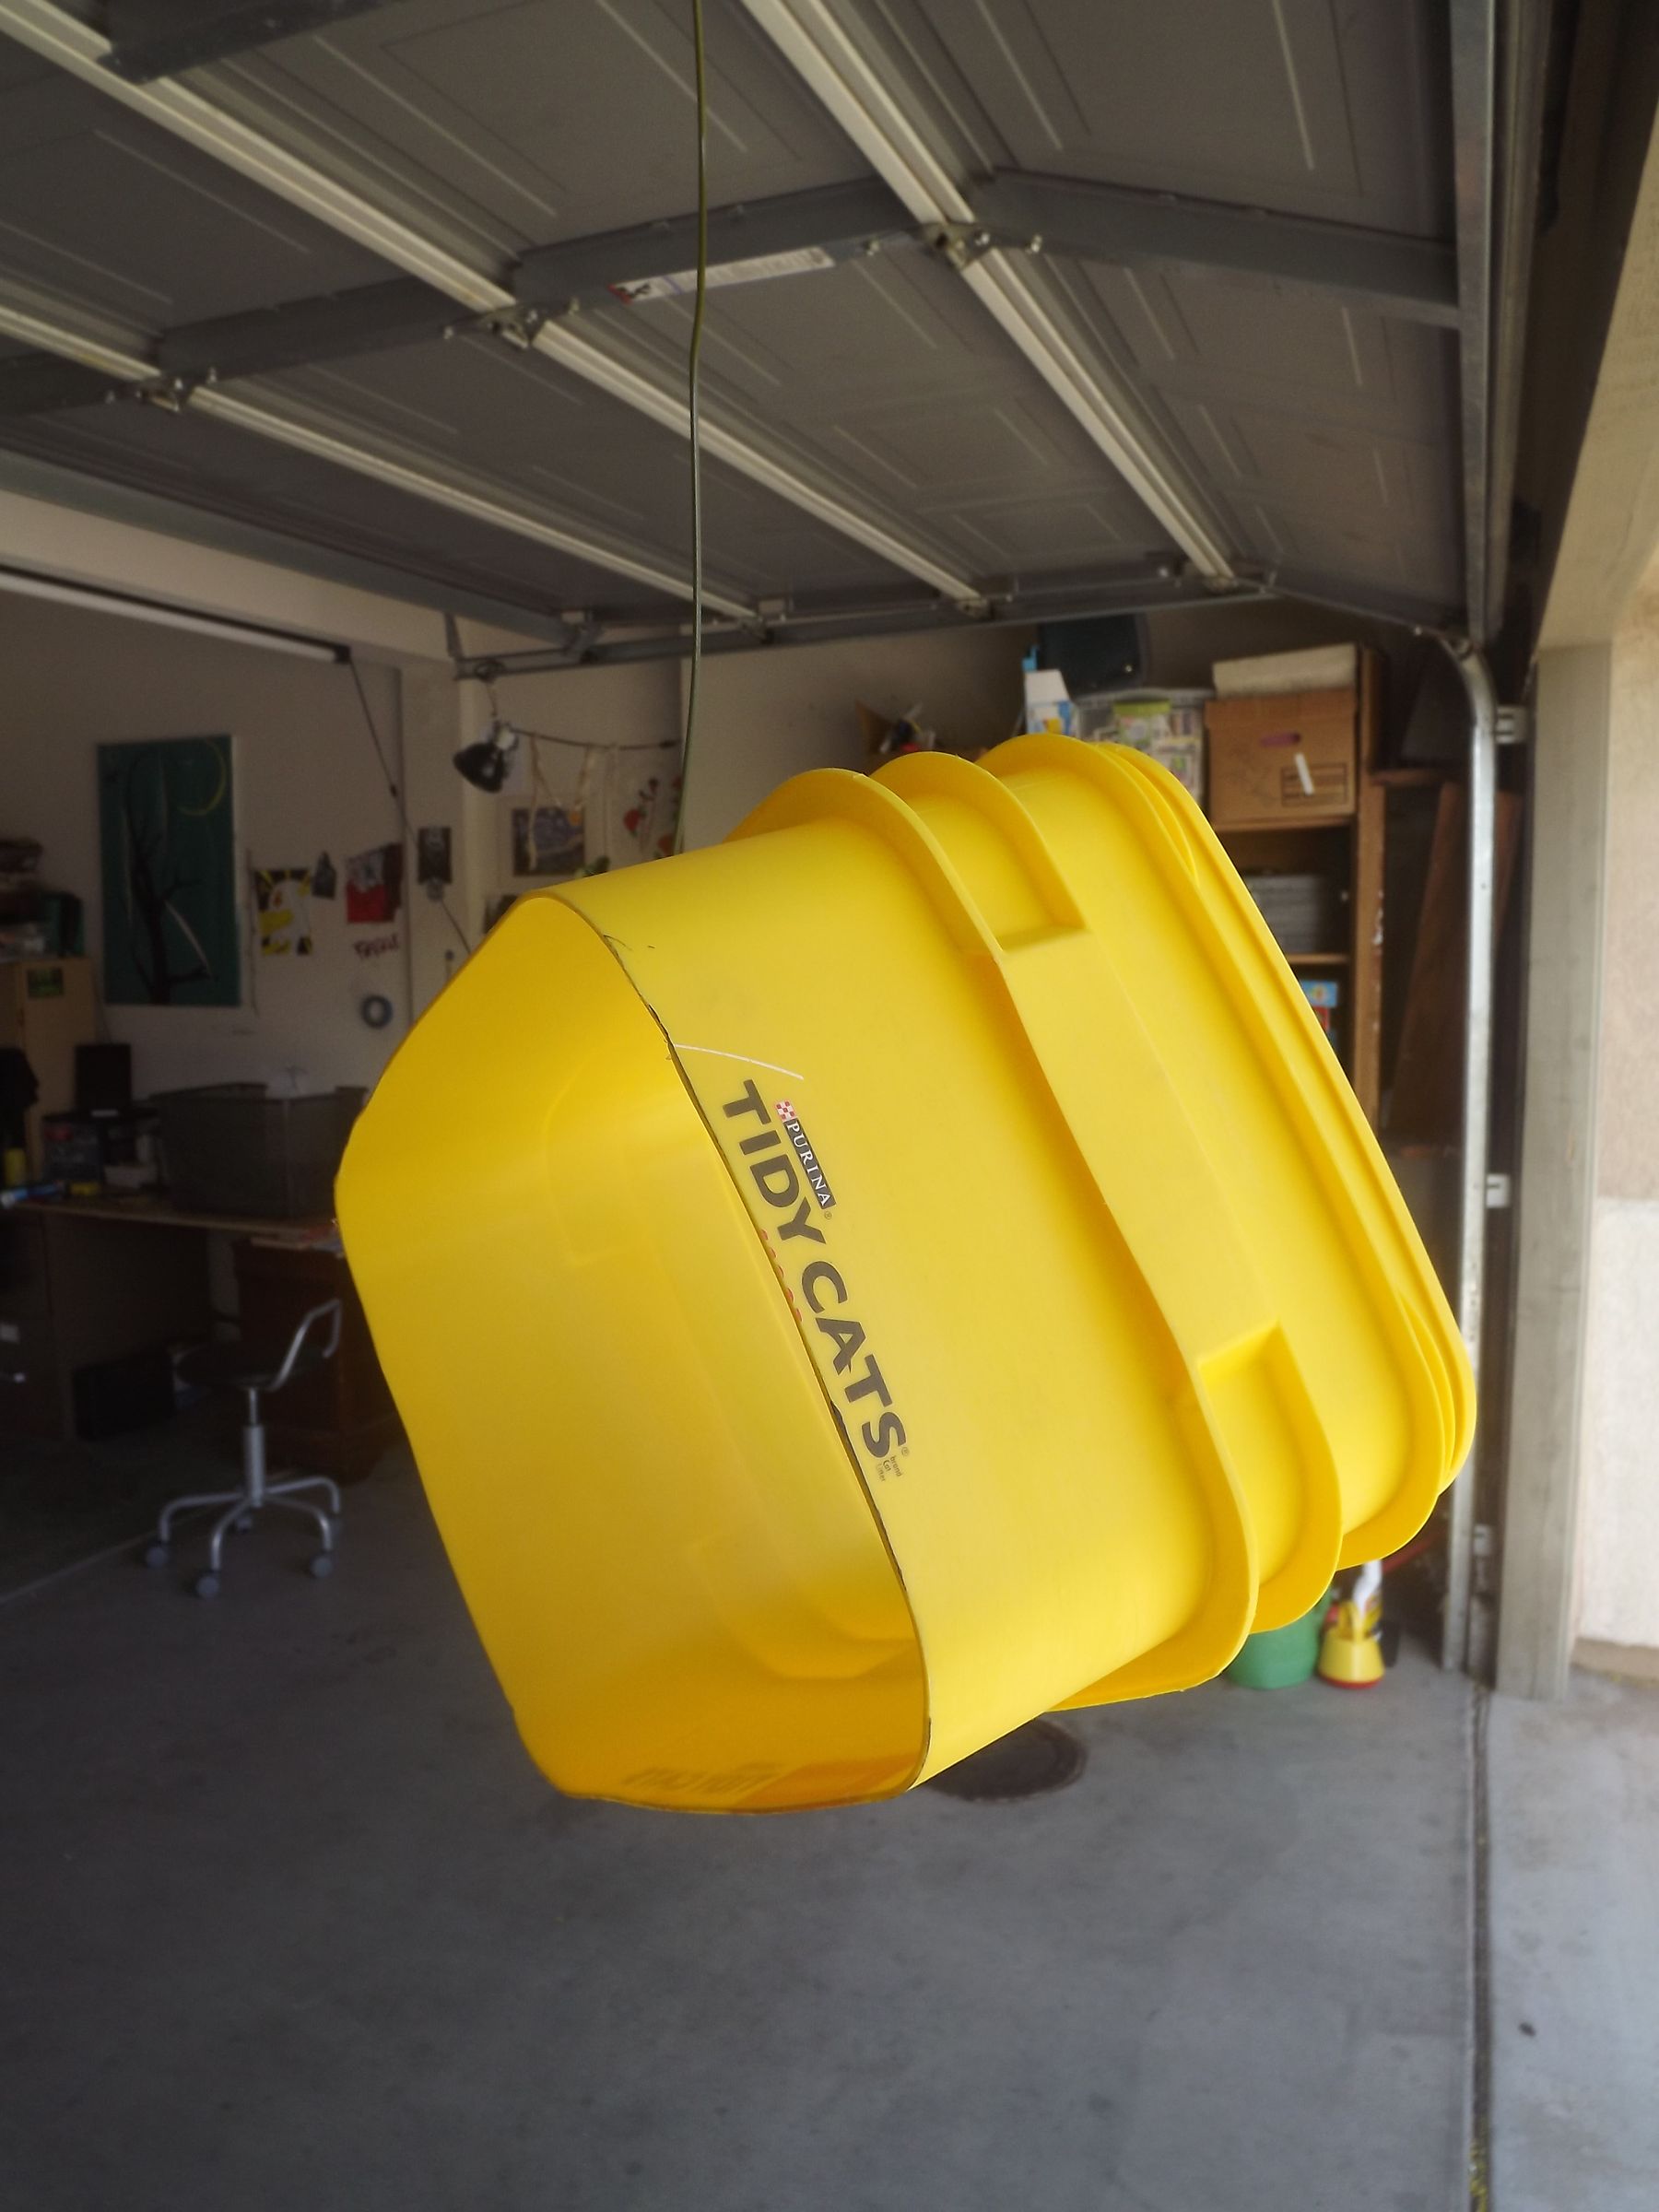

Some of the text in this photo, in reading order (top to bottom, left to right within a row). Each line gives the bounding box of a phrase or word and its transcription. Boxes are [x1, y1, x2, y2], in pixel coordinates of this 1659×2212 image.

[723, 1079, 826, 1244] TIDY
[802, 1261, 906, 1457] CATS
[787, 1122, 831, 1206] PURINA
